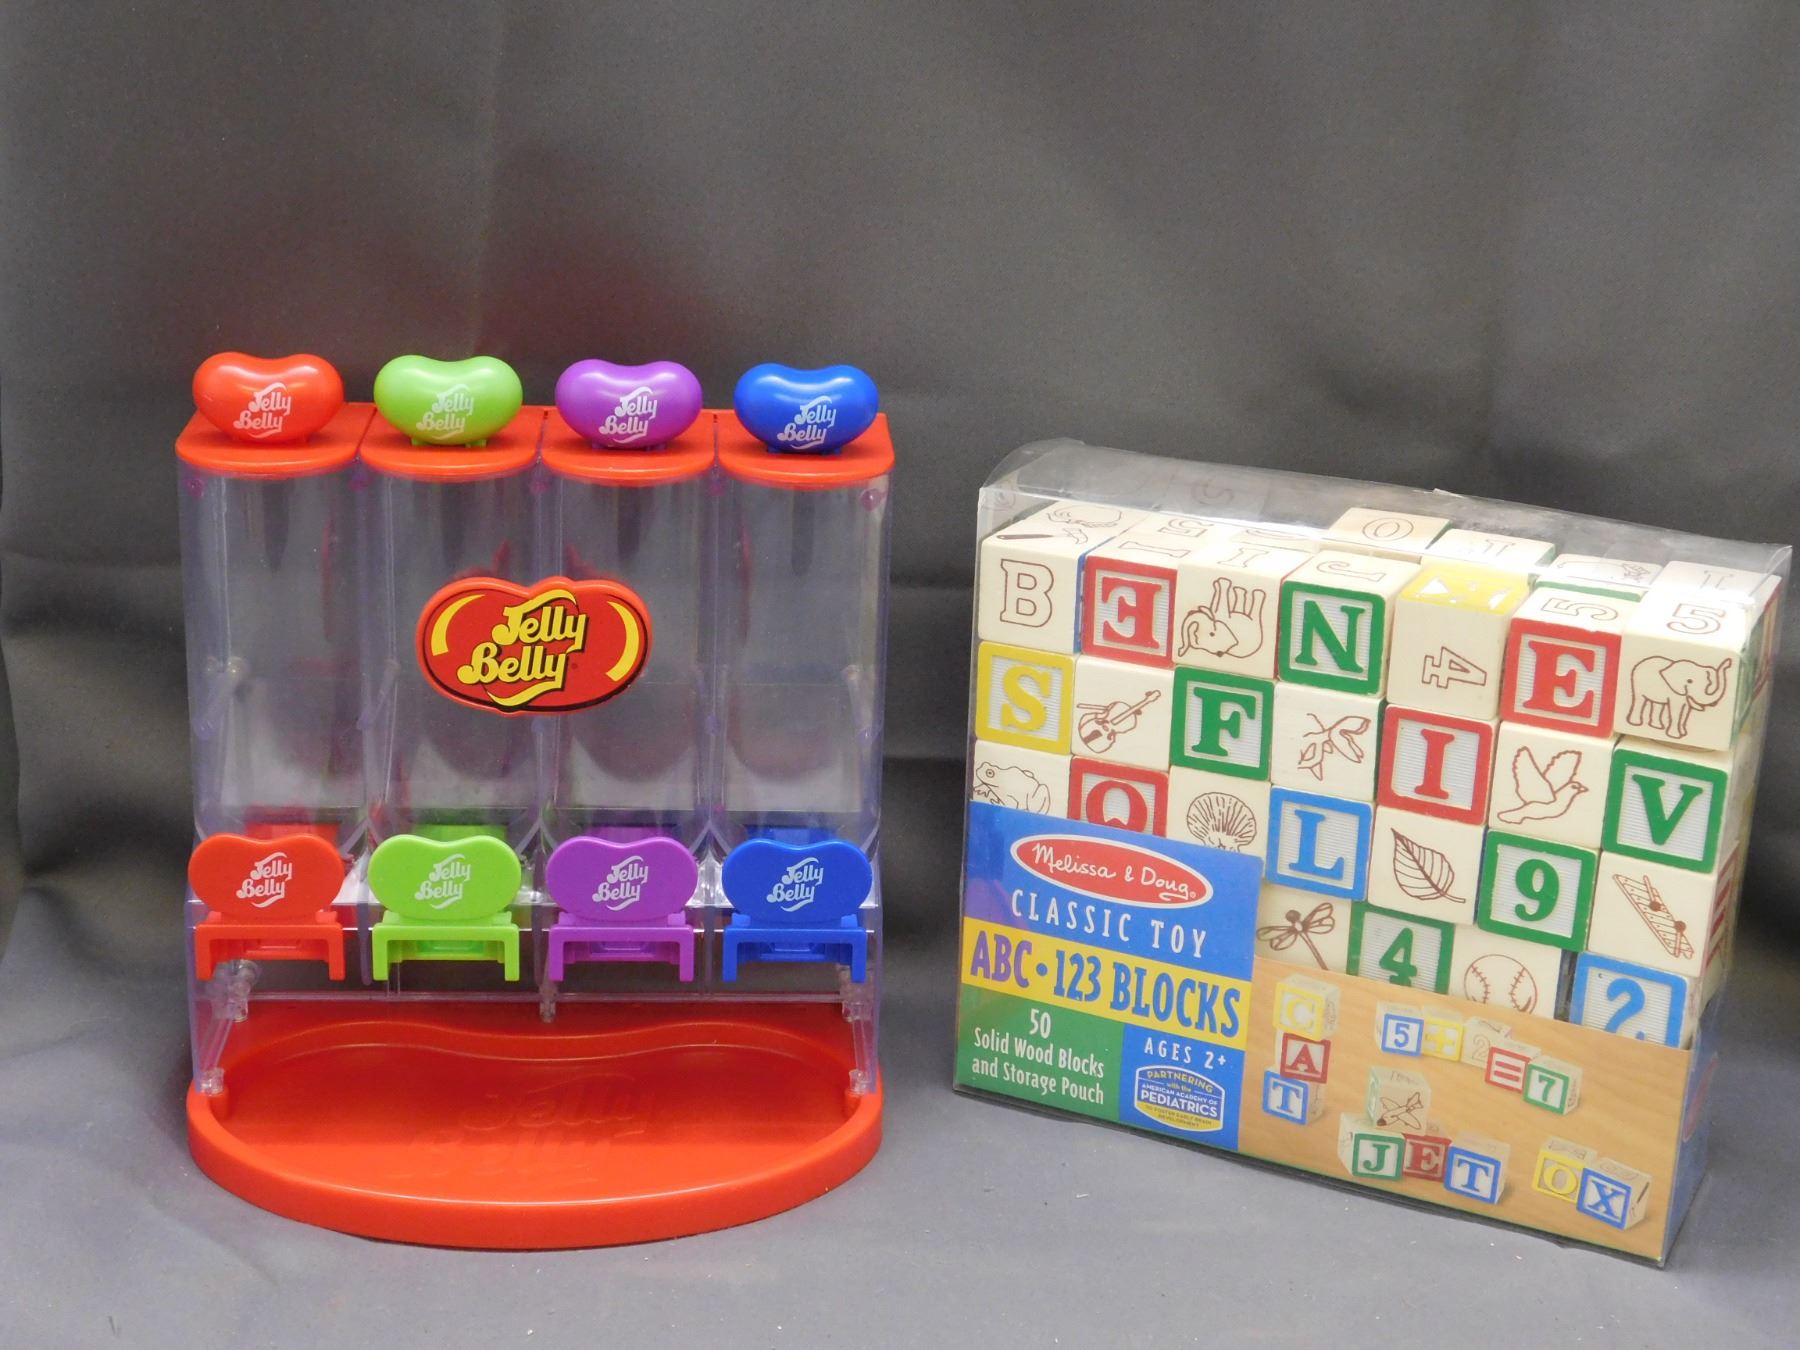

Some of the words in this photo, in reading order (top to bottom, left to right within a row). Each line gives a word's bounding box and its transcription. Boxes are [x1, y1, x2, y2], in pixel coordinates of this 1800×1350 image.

[249, 382, 291, 415] Jelly
[432, 384, 475, 415] Jelly
[615, 387, 657, 419] Jelly
[794, 395, 837, 427] Jelly
[233, 410, 283, 439] Belly
[416, 411, 466, 440] Belly
[598, 416, 649, 444] Belly
[777, 422, 828, 450] Belly
[999, 557, 1055, 628] B
[491, 588, 587, 653] Jelly
[1665, 602, 1727, 635] 5
[1295, 599, 1366, 674] N
[456, 641, 568, 707] Belly
[1421, 646, 1488, 689] 4
[1523, 640, 1597, 719] E
[1001, 664, 1050, 732] S
[1190, 686, 1258, 757] F
[1413, 728, 1456, 800] I
[1631, 774, 1704, 845] V
[1287, 809, 1345, 881] L
[249, 851, 294, 881] Jelly
[429, 853, 472, 883] Jelly
[606, 855, 649, 885] Jelly
[781, 857, 824, 886] Jelly
[1031, 842, 1117, 879] Melissa
[1123, 865, 1135, 883] &
[235, 878, 286, 909] Belly
[414, 880, 464, 910] Belly
[591, 881, 641, 912] Belly
[766, 882, 816, 913] Belly
[1514, 858, 1561, 922] 9
[1011, 889, 1132, 942] CLASSIC
[1151, 919, 1207, 959] TOY
[1378, 927, 1418, 987] 4
[970, 930, 1033, 989] ABC
[1053, 949, 1102, 1002] 123
[1109, 961, 1242, 1039] BLOCKS
[1028, 1008, 1052, 1039] 50
[973, 1026, 1010, 1055] Solid
[1014, 1036, 1054, 1066] Wood
[1058, 1047, 1105, 1079] Blocks
[1144, 1037, 1192, 1064] AGES
[971, 1057, 999, 1078] and
[1002, 1062, 1057, 1096] Storage
[1061, 1076, 1105, 1105] Pouch
[1141, 1083, 1175, 1095] AMERICAN
[1176, 1091, 1208, 1103] ACADEMY
[1146, 1070, 1214, 1093] PARTNERING
[1140, 1089, 1218, 1118] PEDIATRICS
